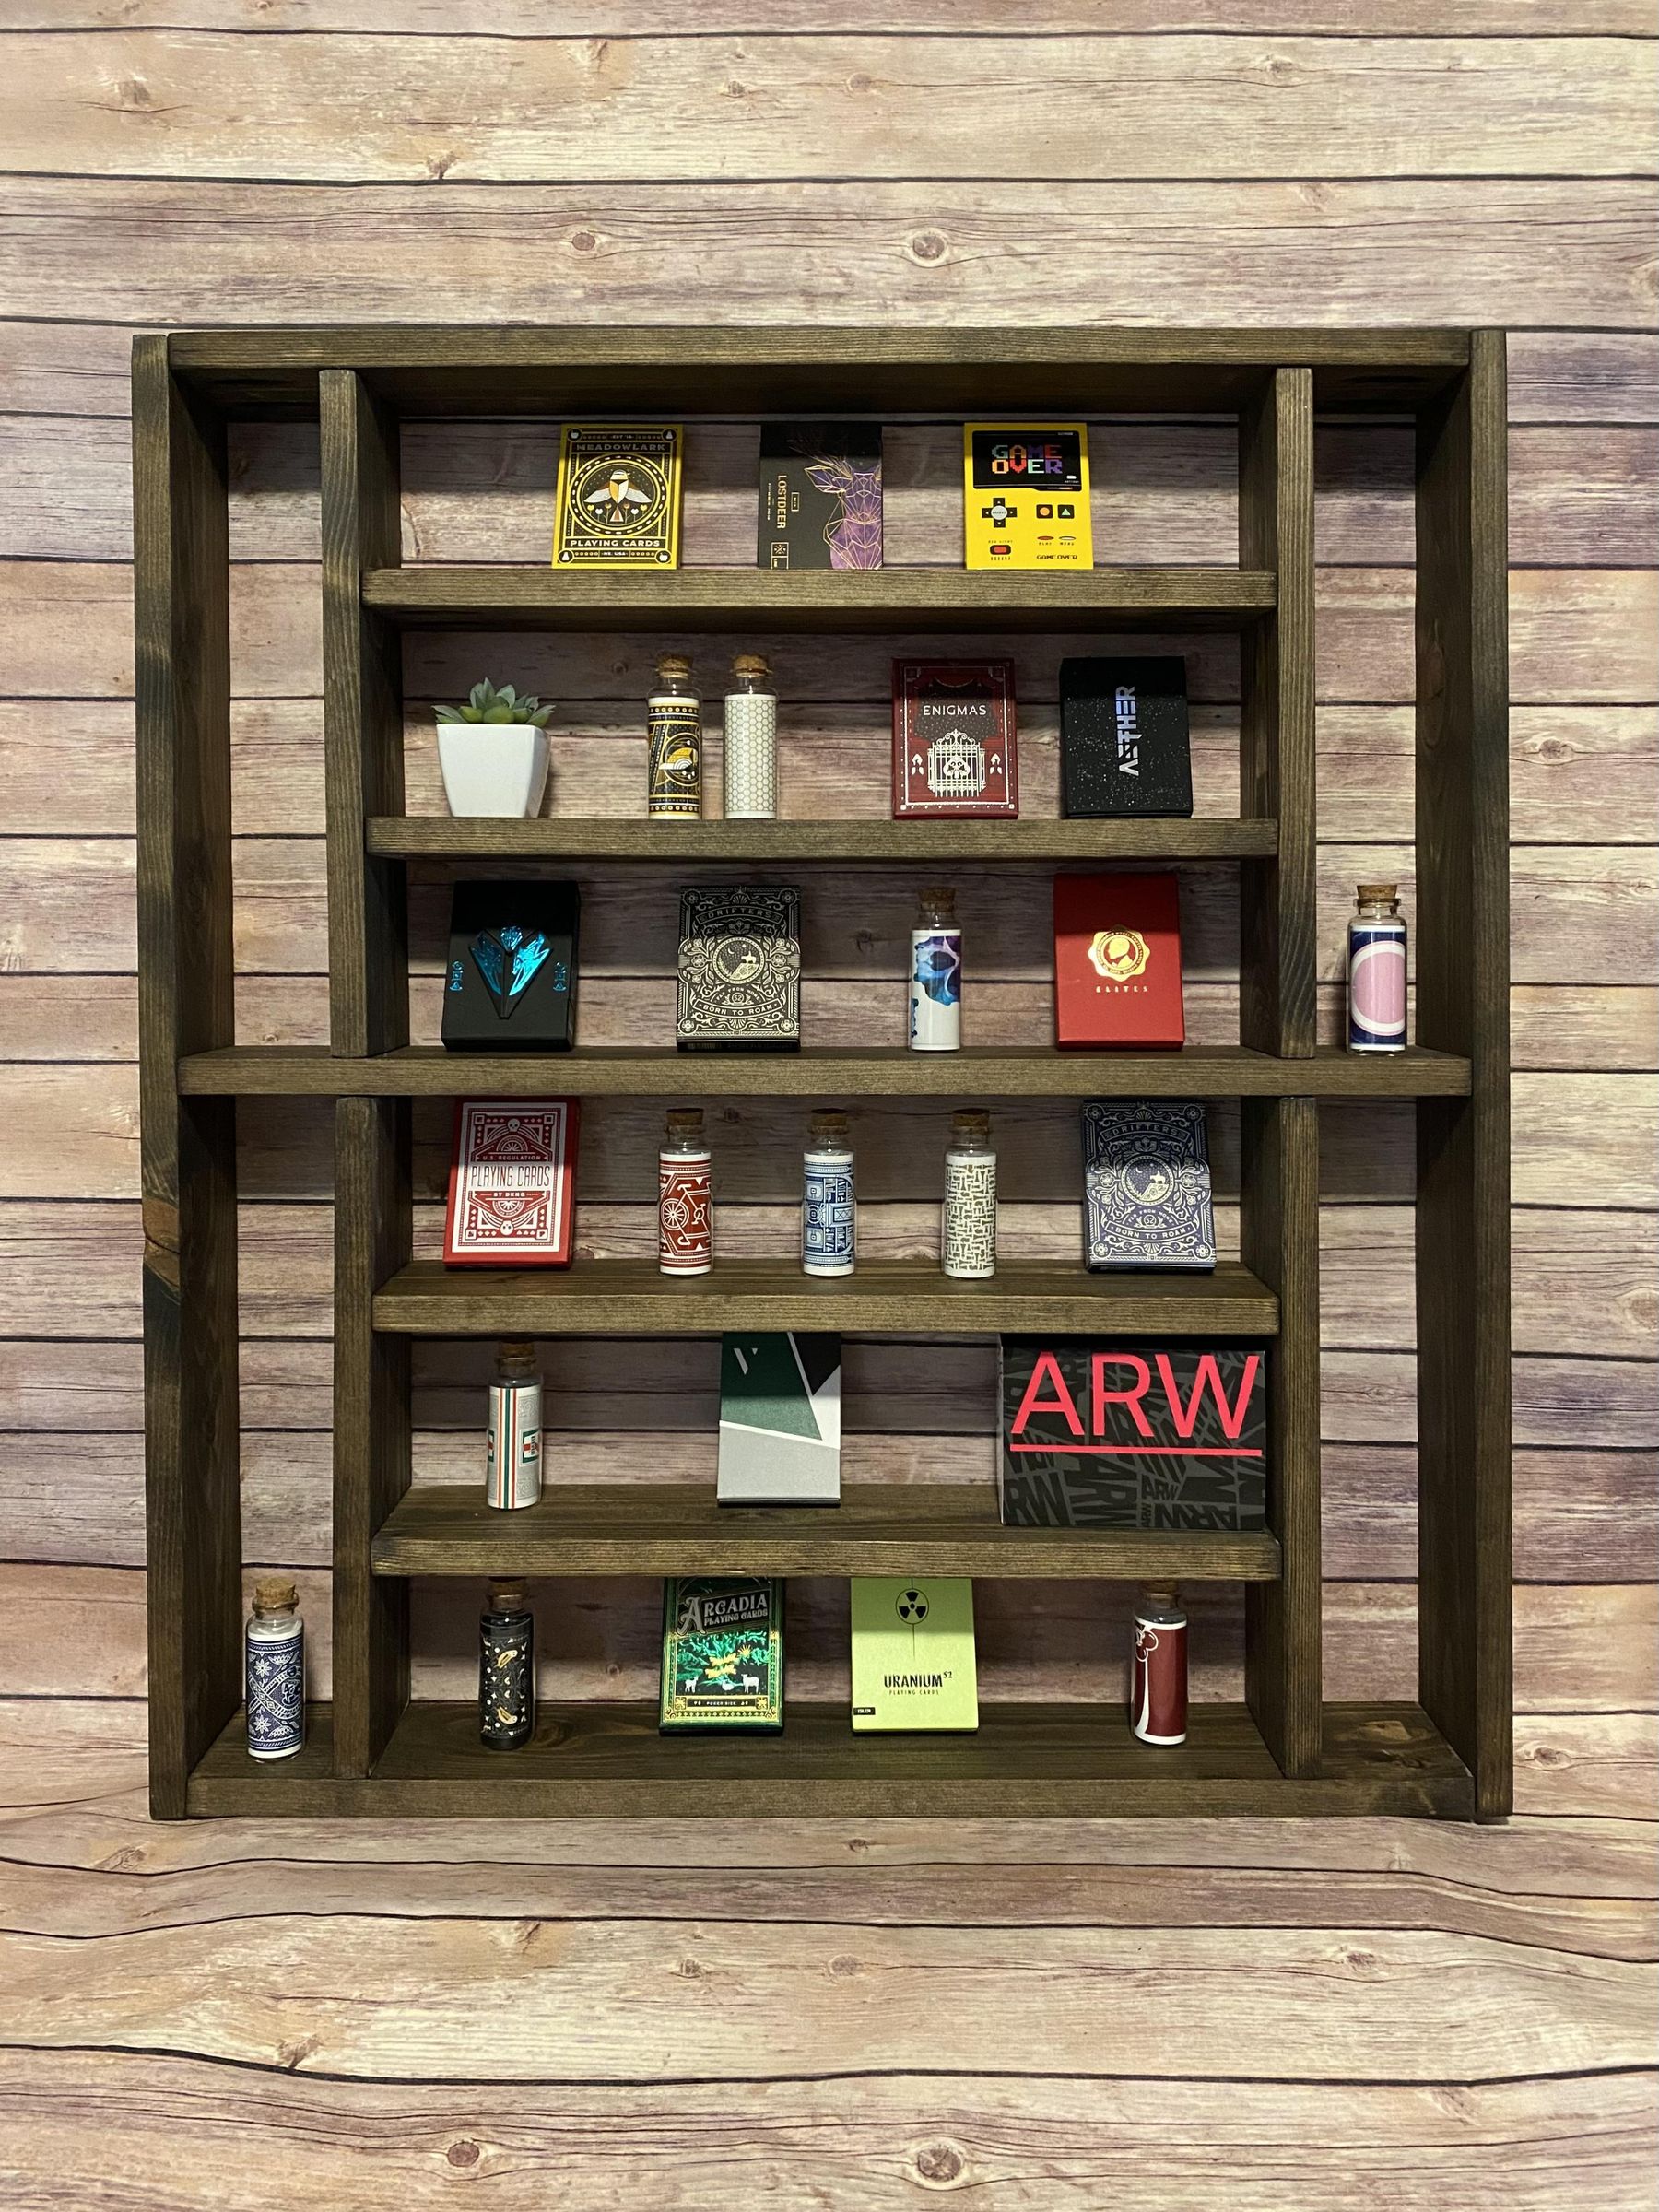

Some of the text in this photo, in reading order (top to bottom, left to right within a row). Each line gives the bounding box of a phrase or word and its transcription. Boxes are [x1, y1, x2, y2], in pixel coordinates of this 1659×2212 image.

[991, 444, 1063, 459] GAME
[991, 458, 1064, 474] OVER
[776, 474, 788, 529] LOSTDEER
[923, 704, 987, 715] ENIGMAS
[708, 907, 771, 919] DRIFTERS
[702, 1004, 727, 1015] BORN
[748, 1005, 773, 1015] ROAM
[1112, 1124, 1179, 1135] DRIFTERS
[470, 1165, 550, 1187] PLAYING CARDS
[1115, 1225, 1140, 1238] BORN
[1162, 1227, 1186, 1239] ROAM
[1010, 1351, 1260, 1439] ARW
[677, 1594, 768, 1636] ARCADIA
[703, 1608, 769, 1627] PLAYING CARDS
[884, 1673, 943, 1688] URANIUM
